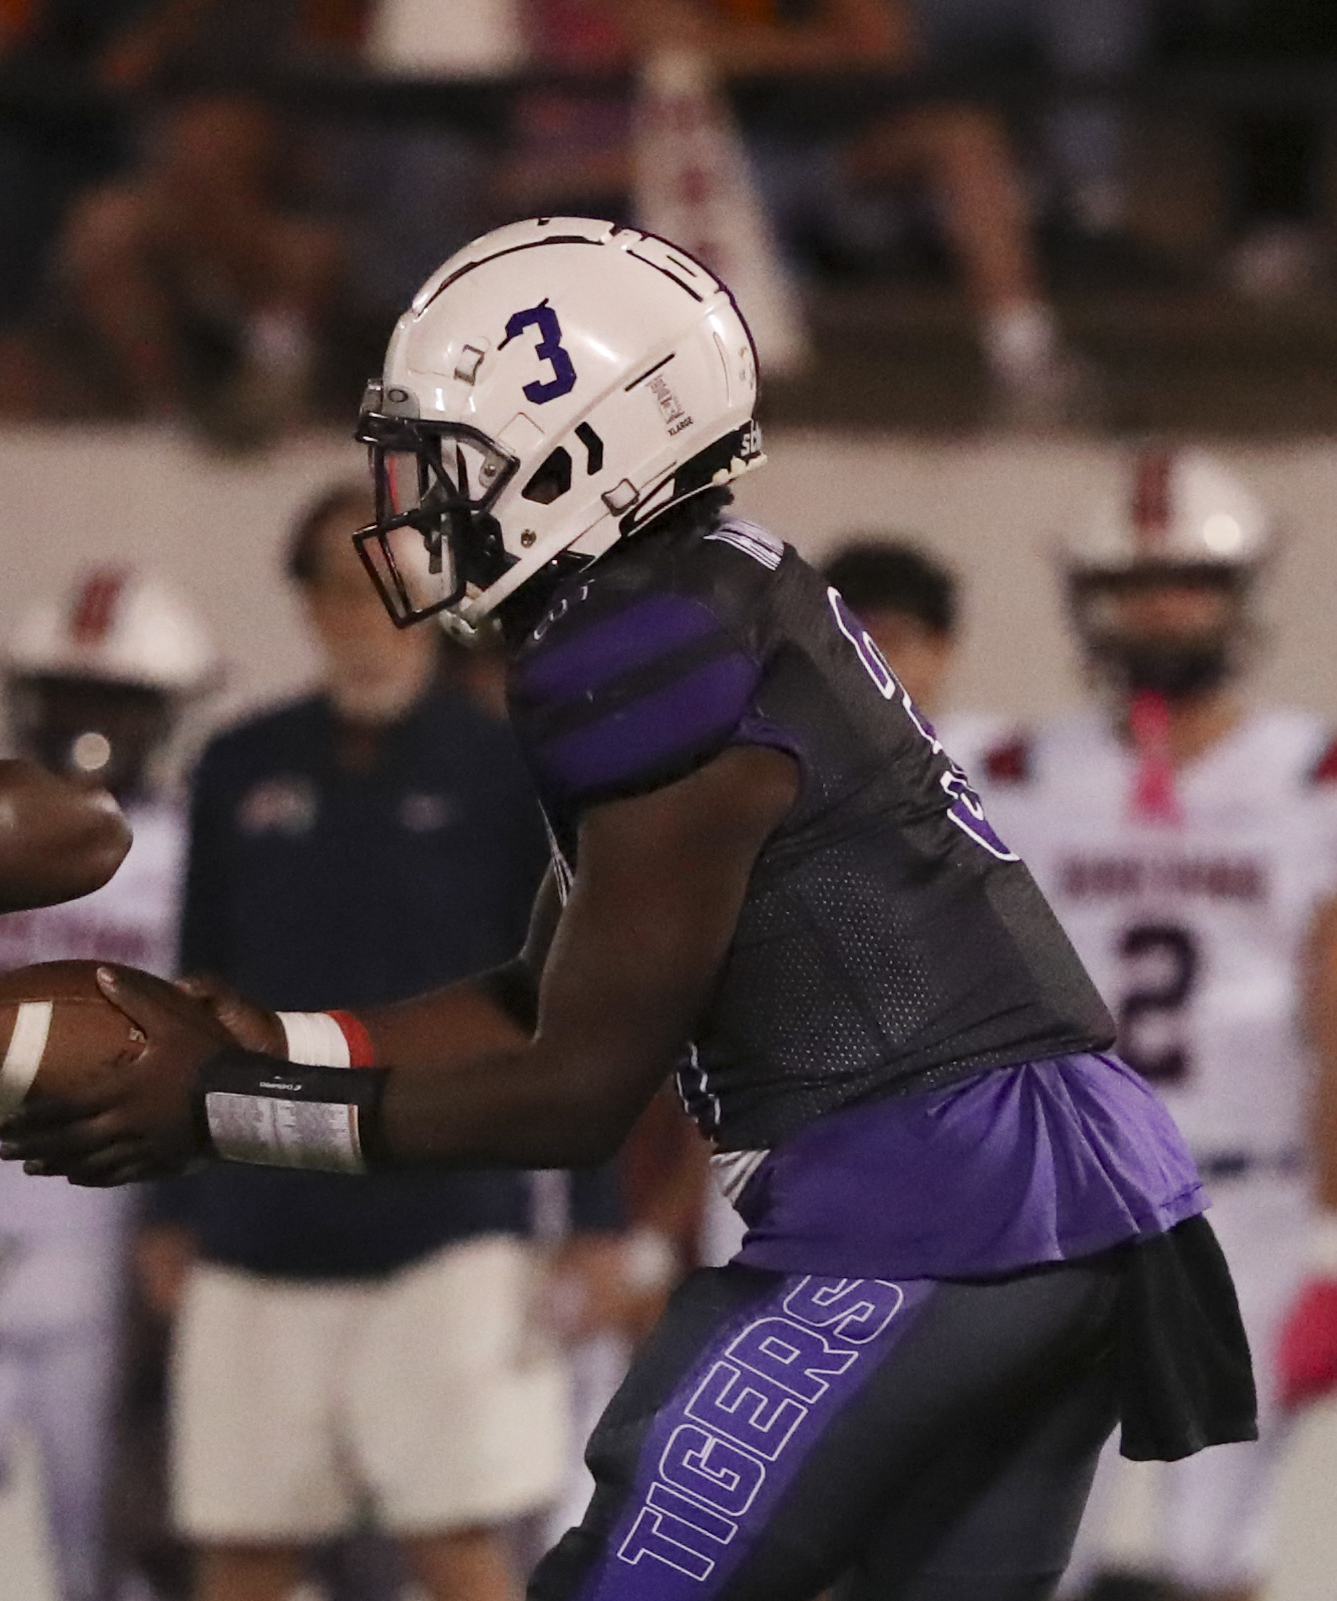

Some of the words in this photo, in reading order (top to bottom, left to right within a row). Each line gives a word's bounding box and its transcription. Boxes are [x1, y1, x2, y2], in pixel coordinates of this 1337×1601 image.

[505, 305, 577, 405] 3
[667, 416, 694, 437] XLARGE
[617, 1274, 903, 1582] TIGERS
